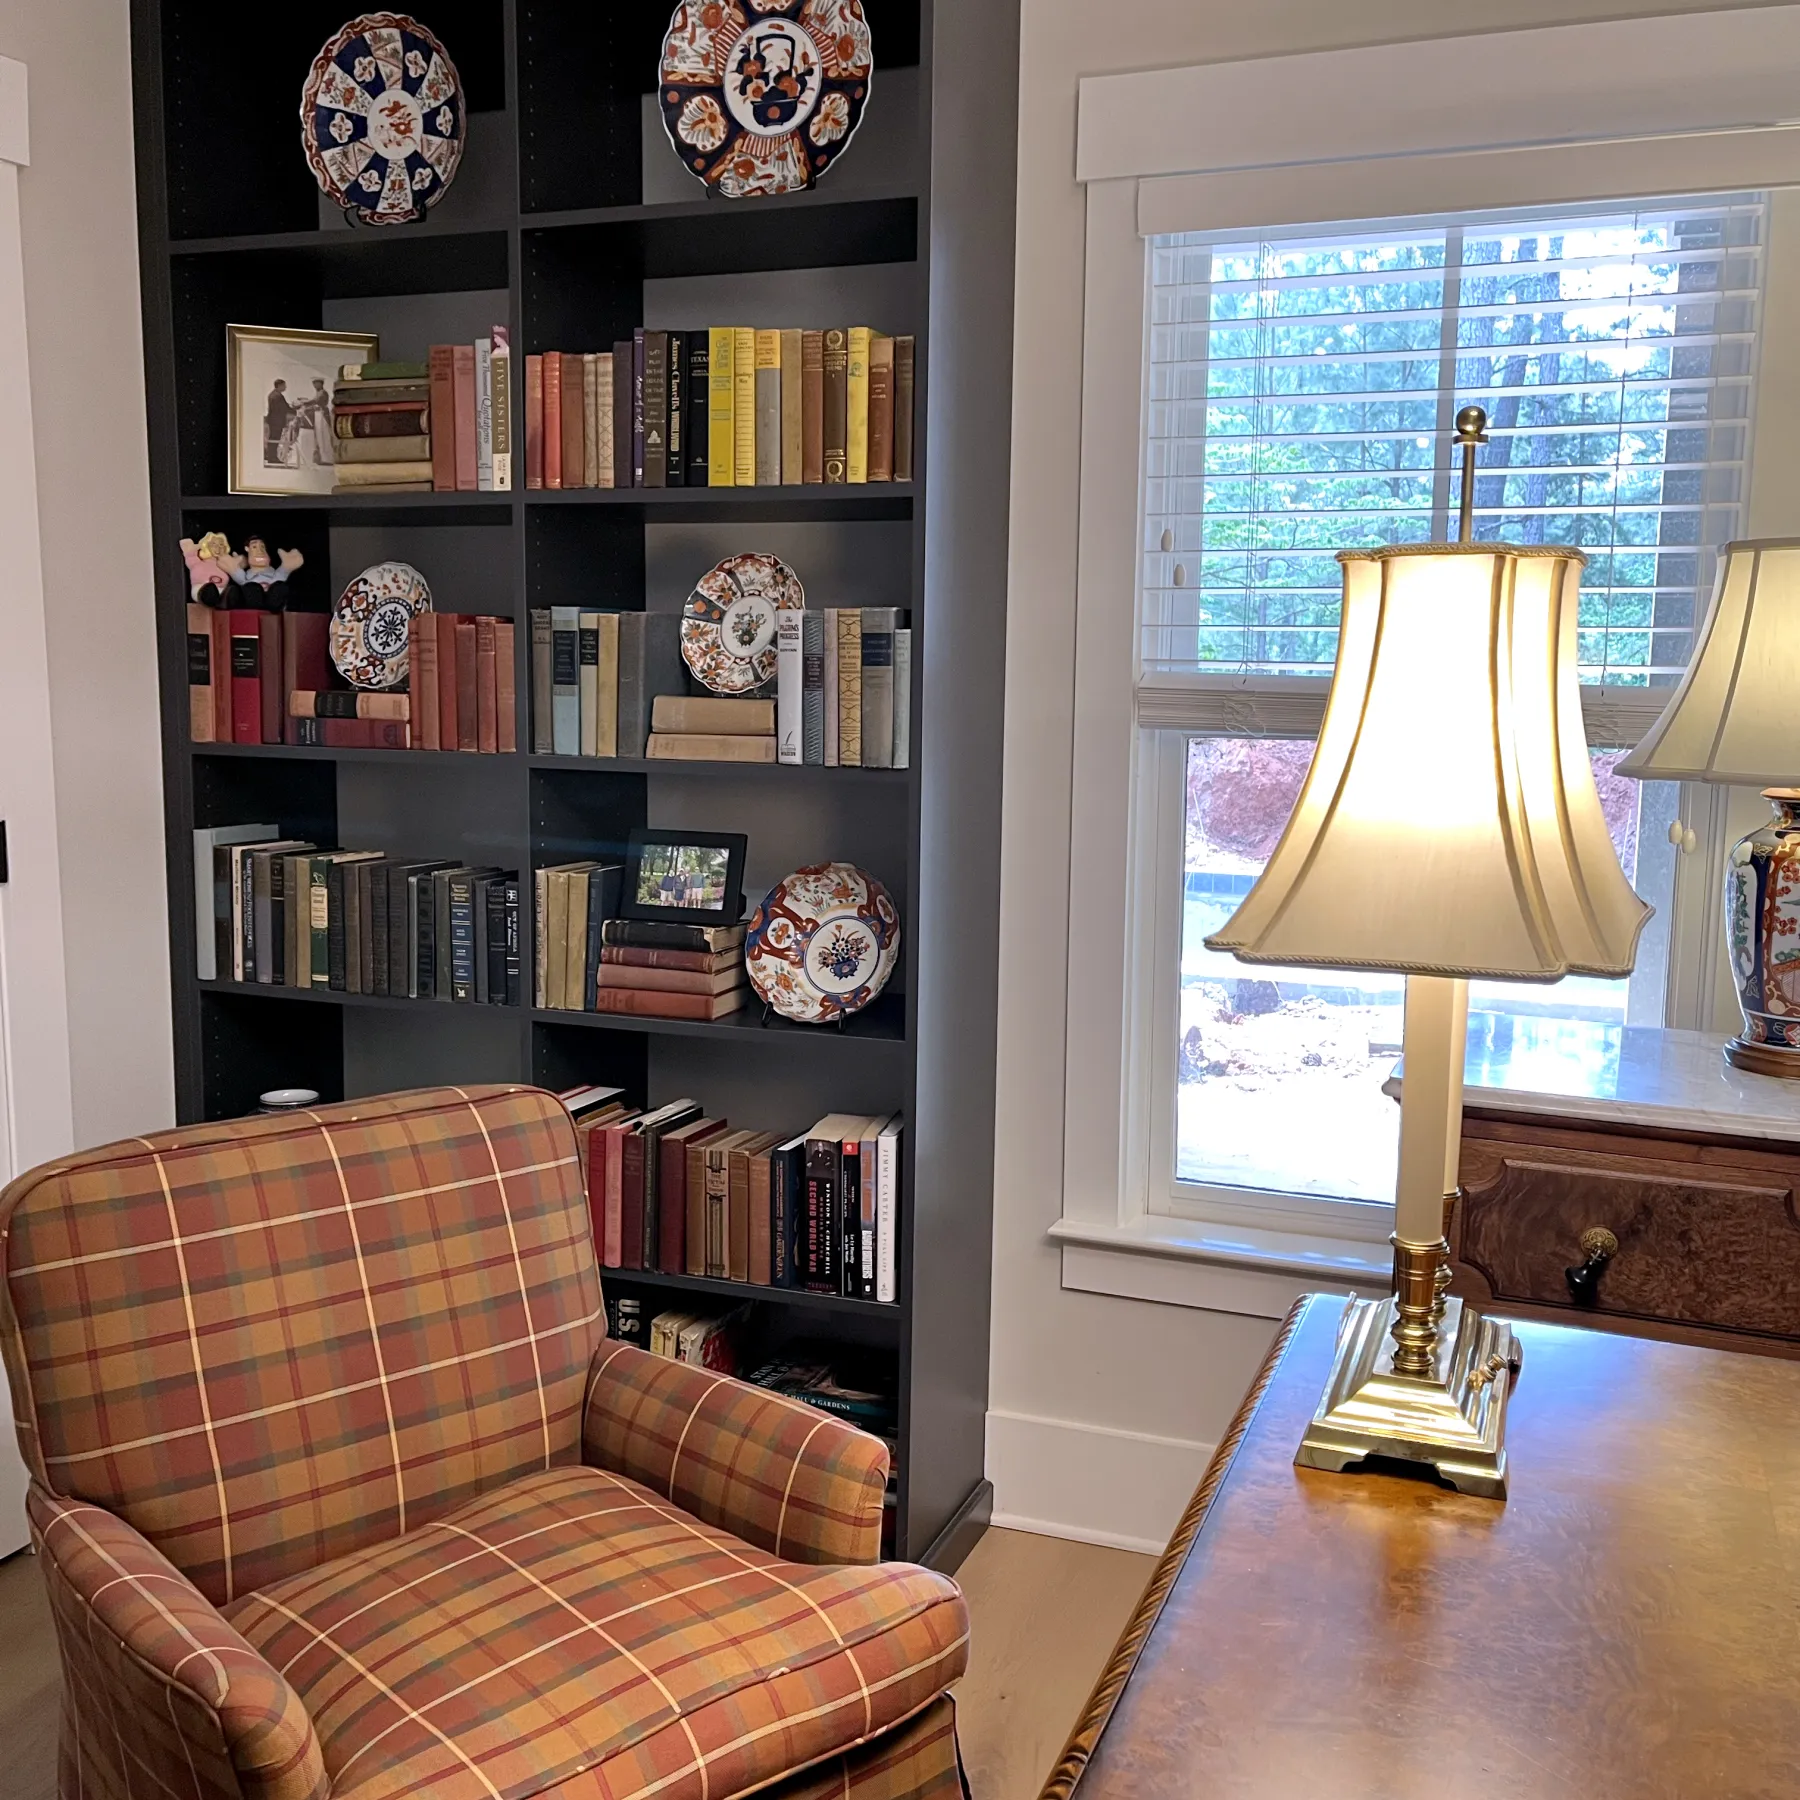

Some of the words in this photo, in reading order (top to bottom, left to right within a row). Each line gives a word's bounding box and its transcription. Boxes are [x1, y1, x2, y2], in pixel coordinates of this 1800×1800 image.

[671, 338, 680, 370] James
[496, 360, 505, 390] FIVE
[482, 398, 492, 444] Quotations
[497, 396, 506, 450] SISTERS
[512, 923, 517, 931] OF
[809, 1180, 817, 1217] SECOND
[809, 1219, 817, 1251] WORLD
[819, 1234, 824, 1242] OF
[809, 1253, 817, 1273] WAR
[618, 1298, 640, 1336] U.S.
[750, 1365, 774, 1379] STAN
[757, 1372, 780, 1386] HALL
[817, 1400, 851, 1410] GARDENS
